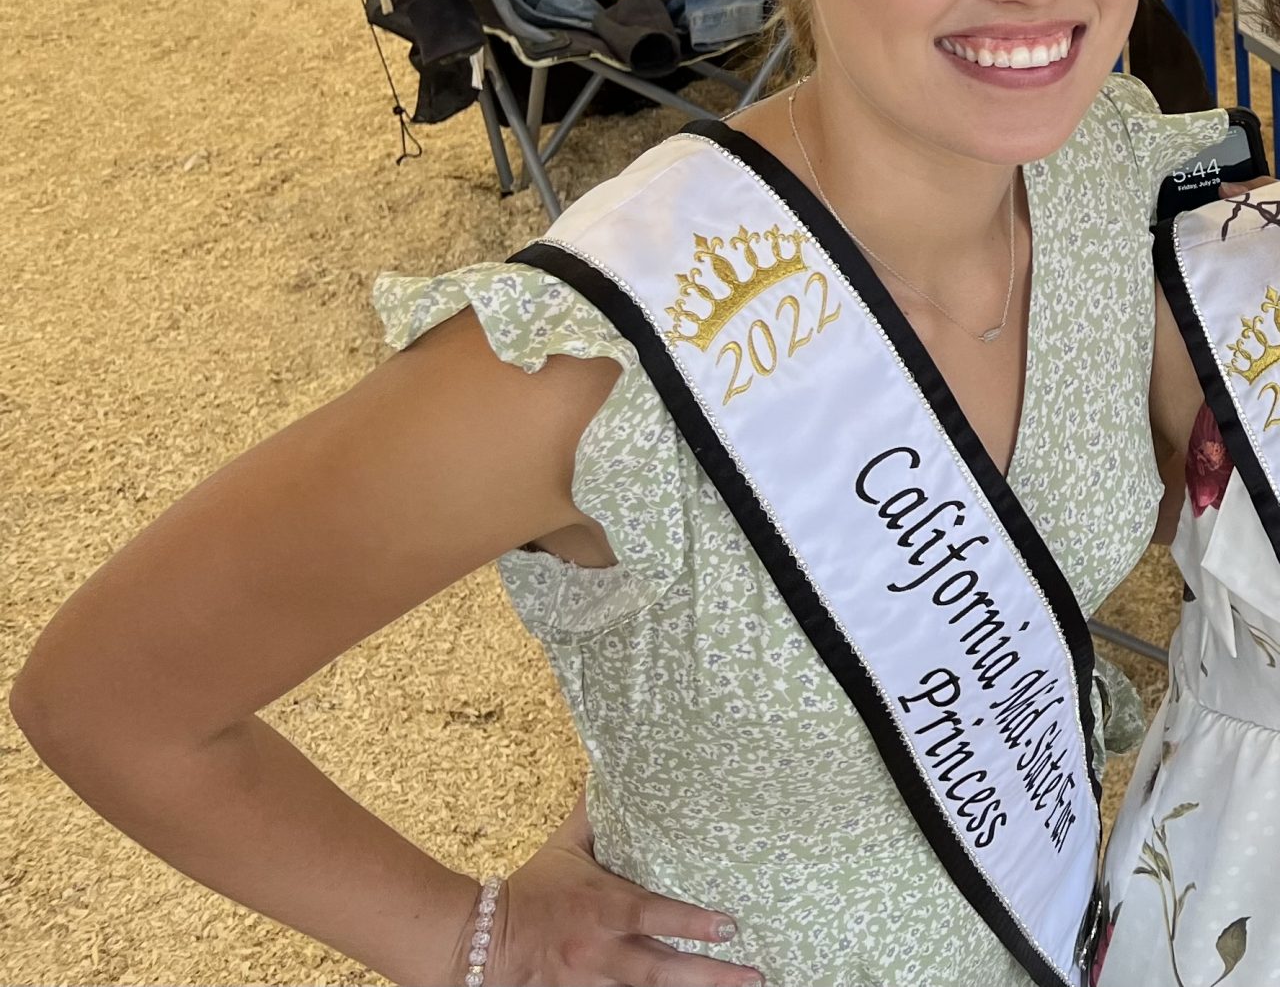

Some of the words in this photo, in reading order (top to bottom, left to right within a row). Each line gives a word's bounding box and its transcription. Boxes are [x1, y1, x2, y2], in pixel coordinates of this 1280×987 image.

[1172, 158, 1221, 183] 5:44
[1177, 183, 1198, 192] Friday,
[1199, 180, 1211, 188] July
[715, 271, 842, 406] 2022
[855, 445, 1026, 690] California
[898, 668, 1010, 849] Princess
